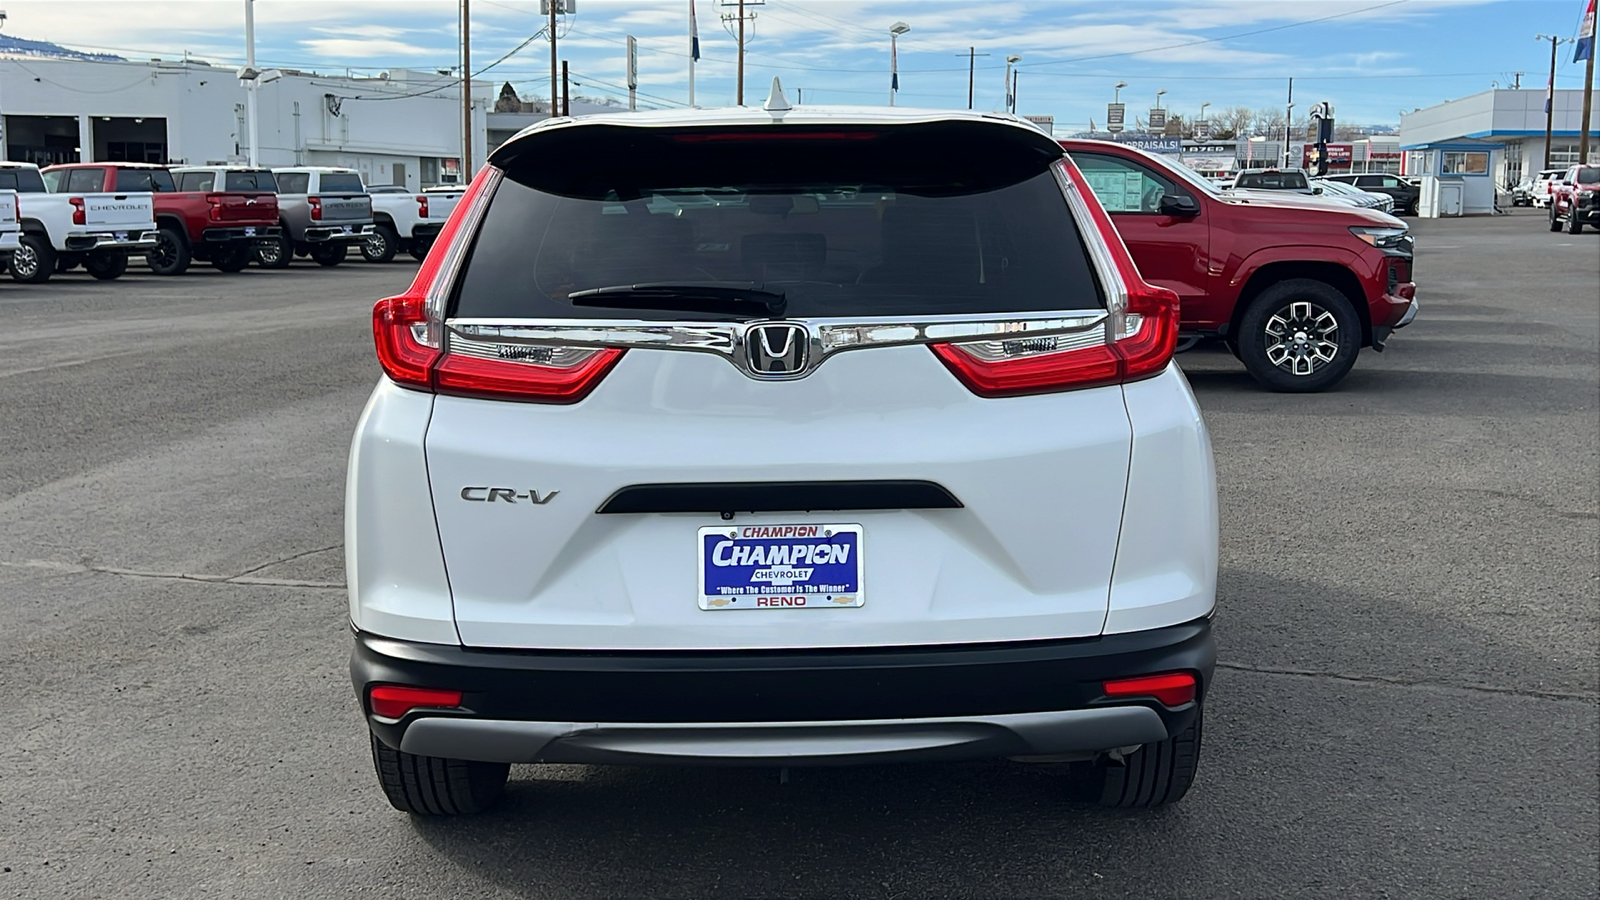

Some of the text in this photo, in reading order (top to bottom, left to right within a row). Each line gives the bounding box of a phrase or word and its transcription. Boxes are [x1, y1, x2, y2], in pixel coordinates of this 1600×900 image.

[460, 486, 561, 505] CR-V
[743, 526, 818, 537] CHAMPION
[712, 541, 850, 566] CHAMPION
[755, 570, 809, 579] CHEVROLET
[746, 586, 759, 594] The
[761, 585, 795, 594] Customer
[805, 584, 819, 593] The
[757, 596, 806, 607] RENO
